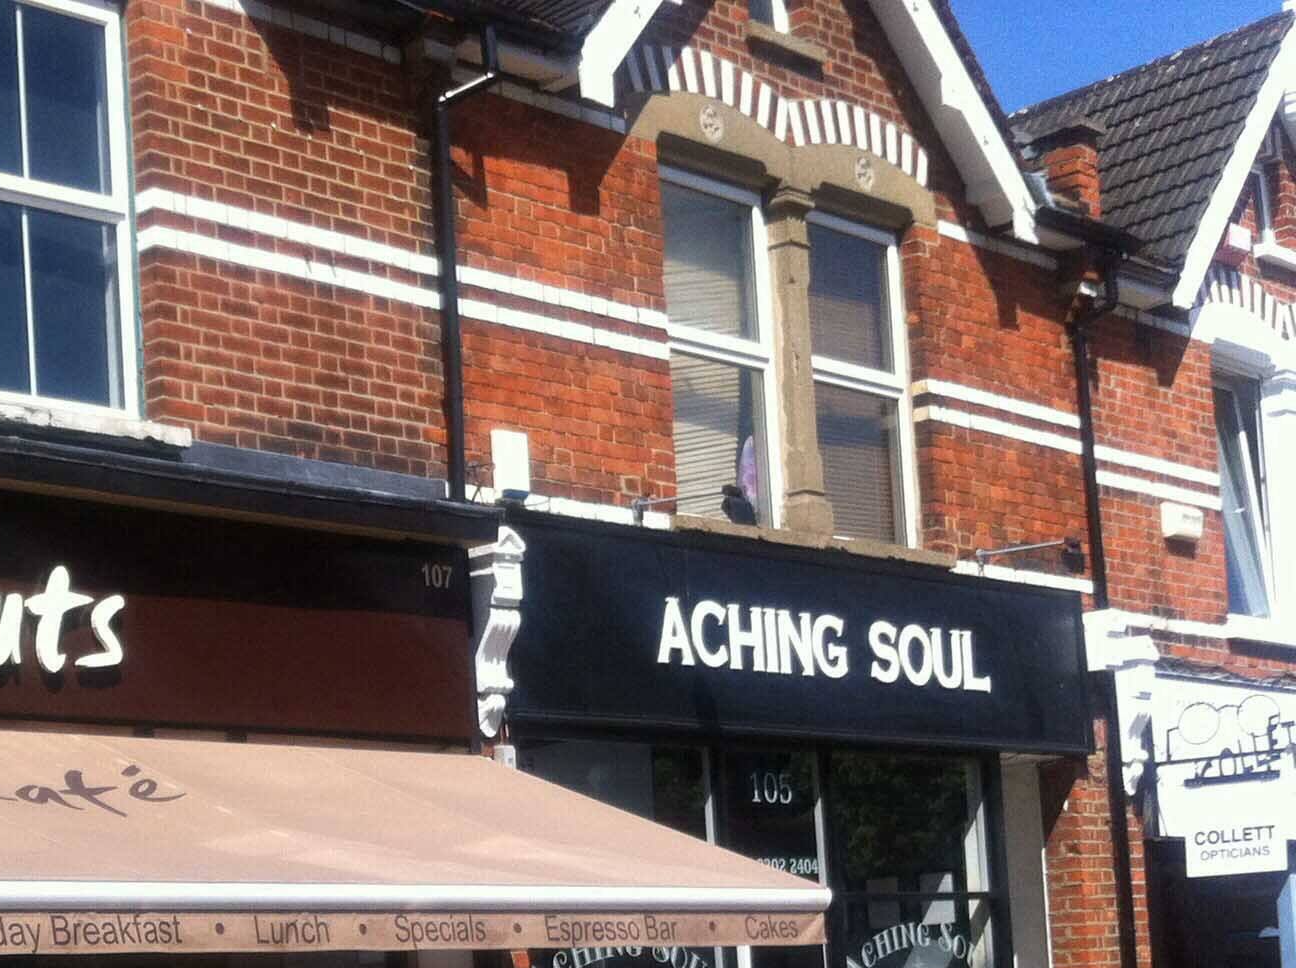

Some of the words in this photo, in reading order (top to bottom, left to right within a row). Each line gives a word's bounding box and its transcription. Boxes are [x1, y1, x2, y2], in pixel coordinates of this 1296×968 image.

[421, 562, 452, 589] 107
[657, 597, 848, 679] ACHING
[868, 620, 991, 693] SOUL
[751, 771, 792, 804] 105
[1194, 825, 1275, 846] COLLETT
[1200, 846, 1271, 862] OPTICIANS
[50, 914, 183, 948] Breakfast
[254, 916, 330, 944] Lunch
[394, 915, 487, 948] Specials
[545, 915, 640, 949] Espresso
[644, 916, 678, 942] Bar
[744, 916, 799, 940] Cakes
